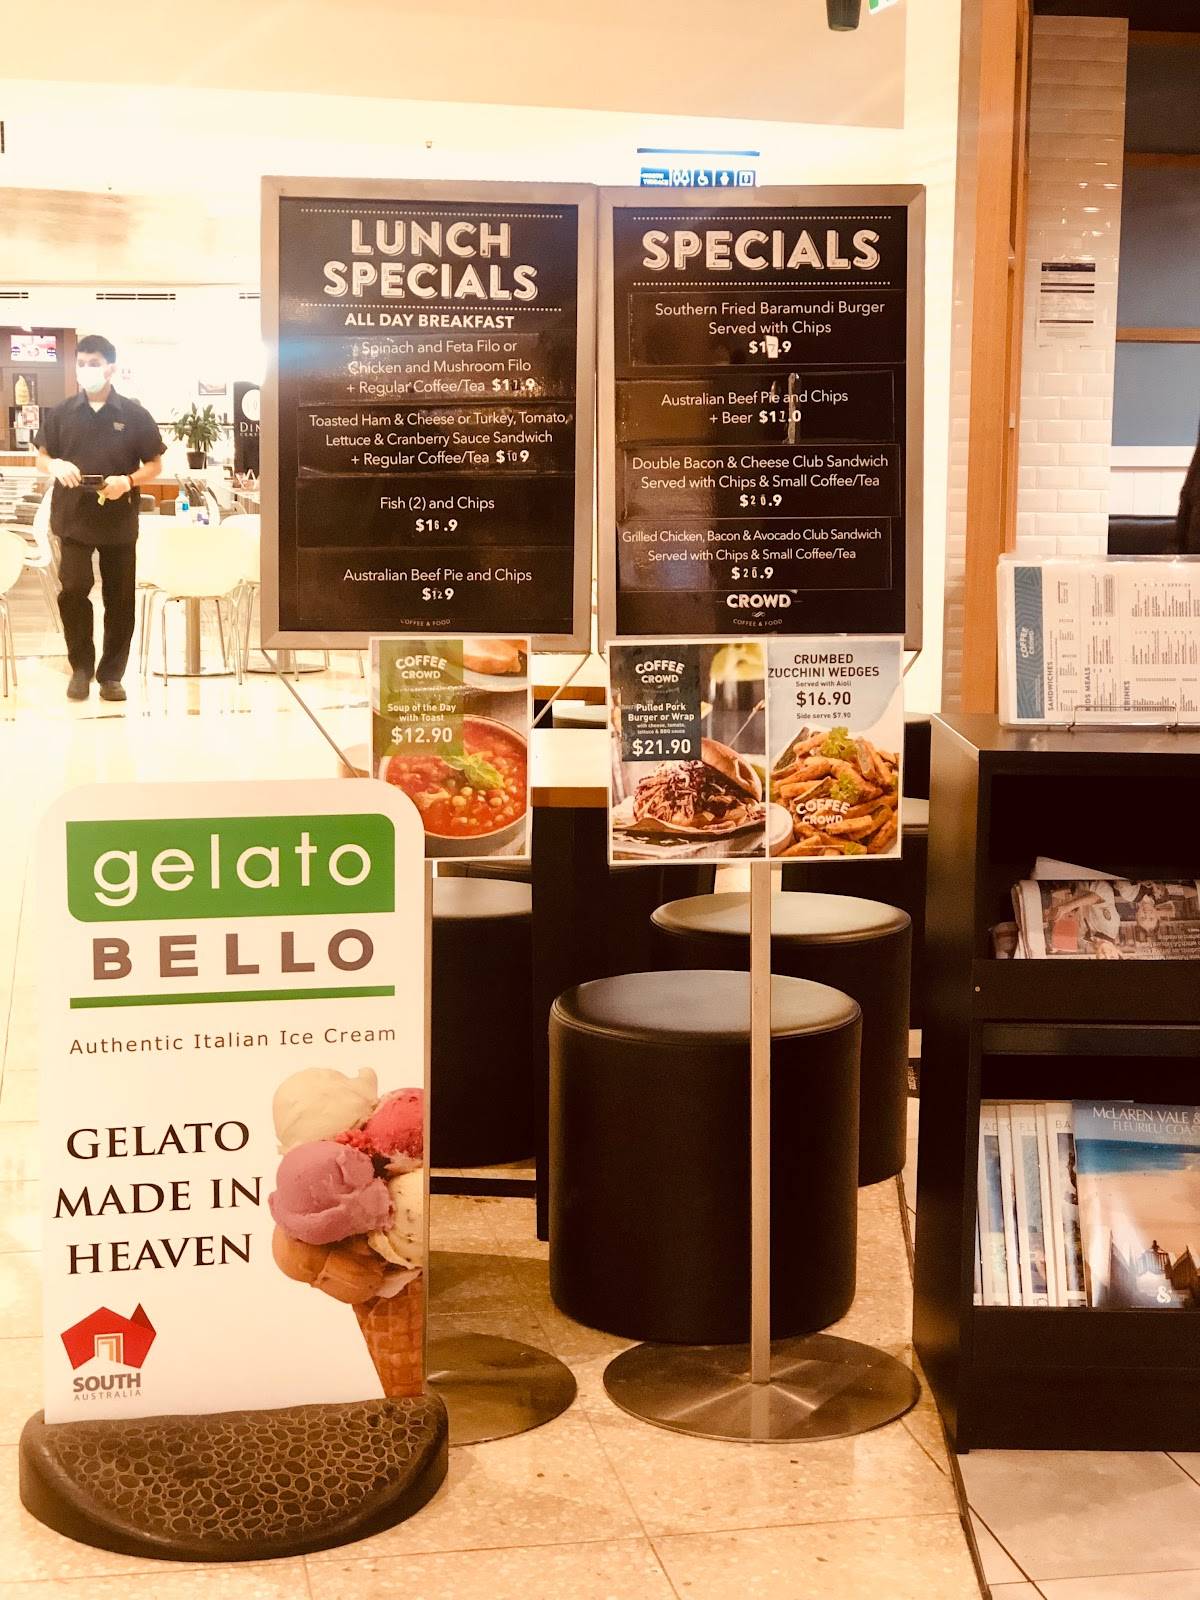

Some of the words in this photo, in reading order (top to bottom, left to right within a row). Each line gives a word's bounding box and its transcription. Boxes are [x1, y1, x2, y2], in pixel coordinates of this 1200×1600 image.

[352, 219, 510, 257] LUNCH
[642, 230, 880, 270] SPECIALS
[323, 261, 538, 301] SPECIALS
[656, 303, 716, 315] Southern
[722, 302, 755, 314] Fried
[760, 301, 834, 314] Baramundi
[839, 302, 884, 316] Burger
[345, 313, 374, 326] ALL
[380, 314, 414, 327] DAY
[418, 315, 514, 329] BREAKFAST
[709, 323, 756, 335] Served
[760, 322, 788, 334] with
[792, 321, 831, 335] Chips
[362, 342, 414, 356] Spinach
[418, 342, 443, 353] and
[446, 341, 474, 353] Feta
[478, 341, 500, 352] Filo
[504, 343, 517, 352] or
[348, 361, 401, 374] Chicken
[405, 361, 429, 373] and
[434, 360, 504, 372] Mushroom
[509, 359, 531, 371] Filo
[359, 381, 411, 397] Regular
[414, 379, 485, 394] Coffee/Tea
[661, 394, 724, 406] Australian
[729, 392, 758, 404] Beef
[761, 392, 779, 402] Pie
[783, 391, 807, 403] and
[811, 391, 848, 404] Chips
[309, 415, 358, 427] Toasted
[362, 415, 391, 425] Ham
[394, 414, 404, 425] &
[407, 413, 454, 425] Cheese
[458, 415, 471, 424] or
[474, 413, 516, 427] Turkey,
[519, 412, 569, 425] Tomato,
[710, 414, 717, 422] +
[723, 412, 752, 424] Beer
[326, 434, 370, 446] Lettuce
[374, 434, 384, 445] &
[387, 433, 449, 448] Cranberry
[453, 433, 489, 444] Sauce
[493, 432, 552, 443] Sandwich
[351, 456, 360, 464] +
[364, 453, 414, 468] Regular
[418, 451, 489, 465] Coffee/Tea
[632, 457, 680, 470] Double
[684, 457, 723, 469] Bacon
[727, 456, 737, 468] &
[741, 456, 789, 468] Cheese
[793, 455, 823, 467] Club
[827, 455, 888, 467] Sandwich
[641, 477, 685, 489] Served
[689, 477, 715, 488] with
[719, 476, 756, 490] Chips
[759, 476, 769, 487] &
[773, 475, 806, 487] Small
[810, 474, 879, 486] Coffee/Tea
[381, 497, 406, 509] Fish
[409, 497, 426, 510] (2)
[429, 497, 453, 508] and
[457, 497, 494, 511] Chips
[622, 531, 657, 542] Grilled
[660, 531, 705, 544] Chicken,
[708, 531, 740, 541] Bacon
[743, 531, 751, 541] &
[753, 530, 800, 540] Avocado
[803, 529, 828, 540] Club
[831, 529, 881, 540] Sandwich
[648, 550, 688, 561] Served
[691, 550, 713, 561] with
[716, 550, 748, 562] Chips
[751, 549, 759, 560] &
[763, 549, 792, 559] Small
[796, 548, 856, 559] Coffee/Tea
[344, 569, 407, 581] Australian
[411, 569, 440, 580] Beef
[444, 569, 463, 580] Pie
[467, 568, 491, 580] and
[495, 569, 531, 583] Chips
[726, 594, 791, 608] CROWD
[733, 618, 755, 626] COFFEE
[395, 655, 447, 670] COFFEE
[794, 654, 853, 664] CRUMBED
[635, 660, 684, 674] COFFEE
[768, 668, 824, 678] ZUCCHINI
[829, 667, 879, 677] WEDGES
[401, 671, 440, 679] CROWD
[641, 675, 678, 684] CROWD
[796, 691, 851, 707] $16.90
[388, 704, 409, 713] Soup
[412, 704, 421, 712] of
[440, 704, 456, 713] Day
[636, 703, 663, 711] Pulled
[666, 703, 686, 711] Pork
[628, 713, 657, 722] Burger
[672, 713, 694, 722] Wrap
[392, 726, 452, 745] $12.90
[632, 738, 690, 756] $21.90
[796, 799, 850, 814] COFFEE
[802, 815, 843, 825] CROWD
[93, 832, 371, 907] gelato
[93, 929, 374, 980] BELLO
[70, 1035, 182, 1055] Authentic
[194, 1031, 269, 1049] Italian
[280, 1029, 313, 1045] Ice
[324, 1027, 396, 1044] Cream
[1093, 1106, 1153, 1121] McLAREN
[1157, 1110, 1189, 1124] VALE
[1113, 1120, 1162, 1134] FLEURIEU
[67, 1120, 250, 1160] GELATO
[52, 1181, 191, 1219] MADE
[210, 1176, 263, 1209] IN
[67, 1233, 252, 1275] HEAVEN
[73, 1373, 141, 1393] SOUTH
[74, 1389, 141, 1401] AUSTRALIA
